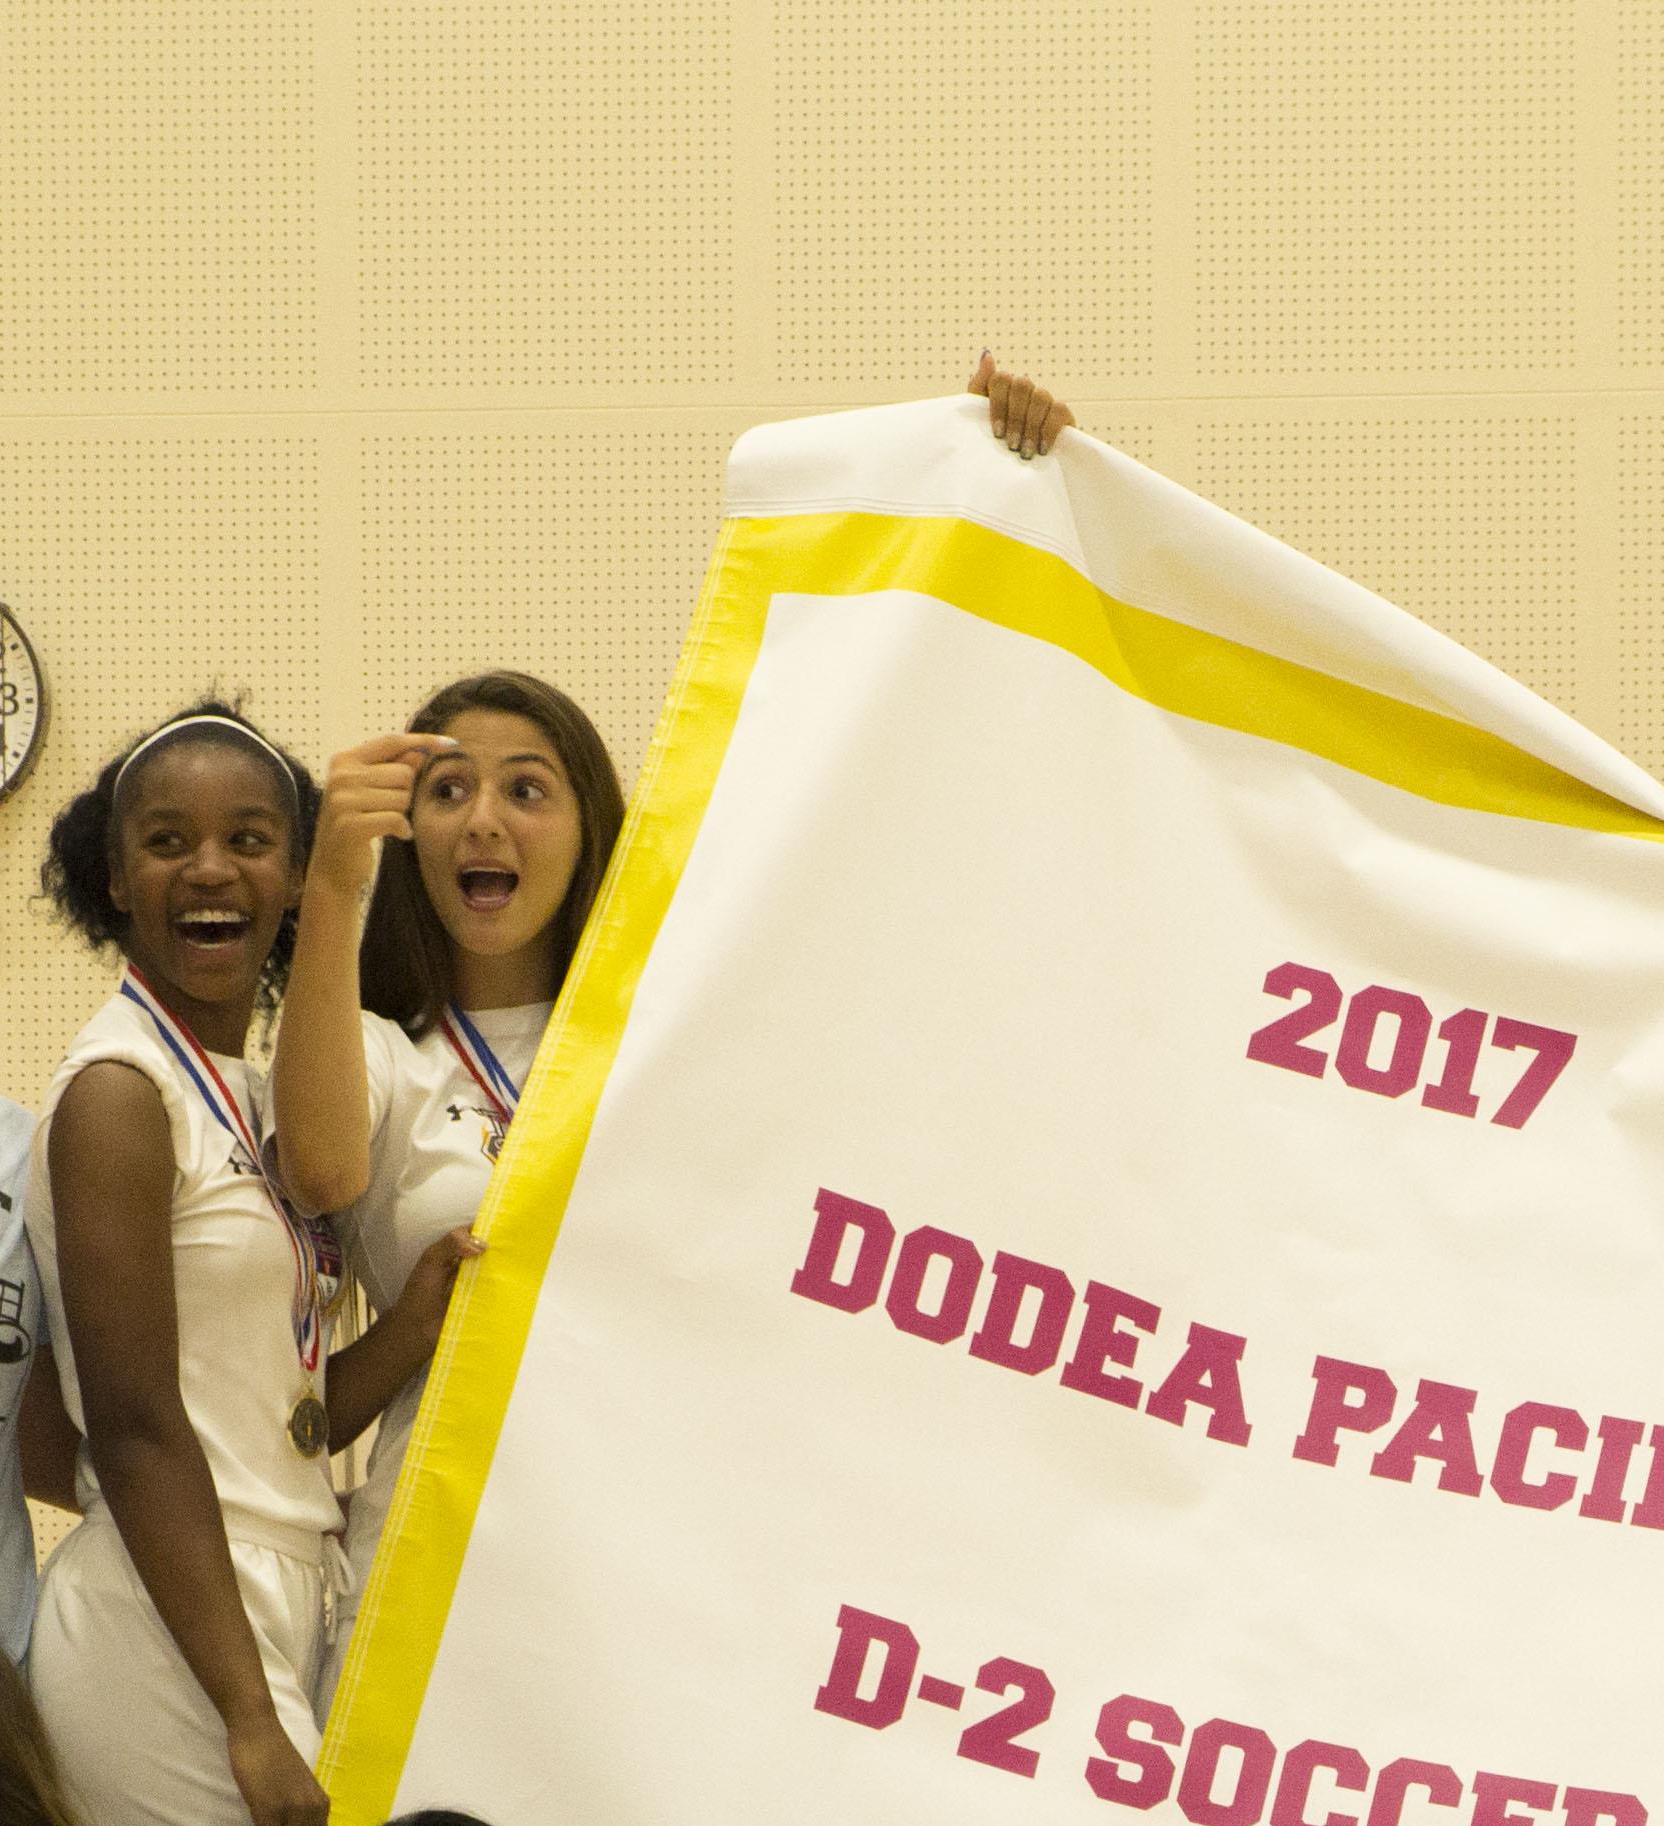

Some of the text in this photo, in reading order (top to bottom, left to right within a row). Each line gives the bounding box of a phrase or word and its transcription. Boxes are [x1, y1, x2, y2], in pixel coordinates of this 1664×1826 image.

[1246, 961, 1577, 1130] 2017
[790, 1187, 1252, 1447] DODEA
[813, 1603, 1057, 1779] D-2
